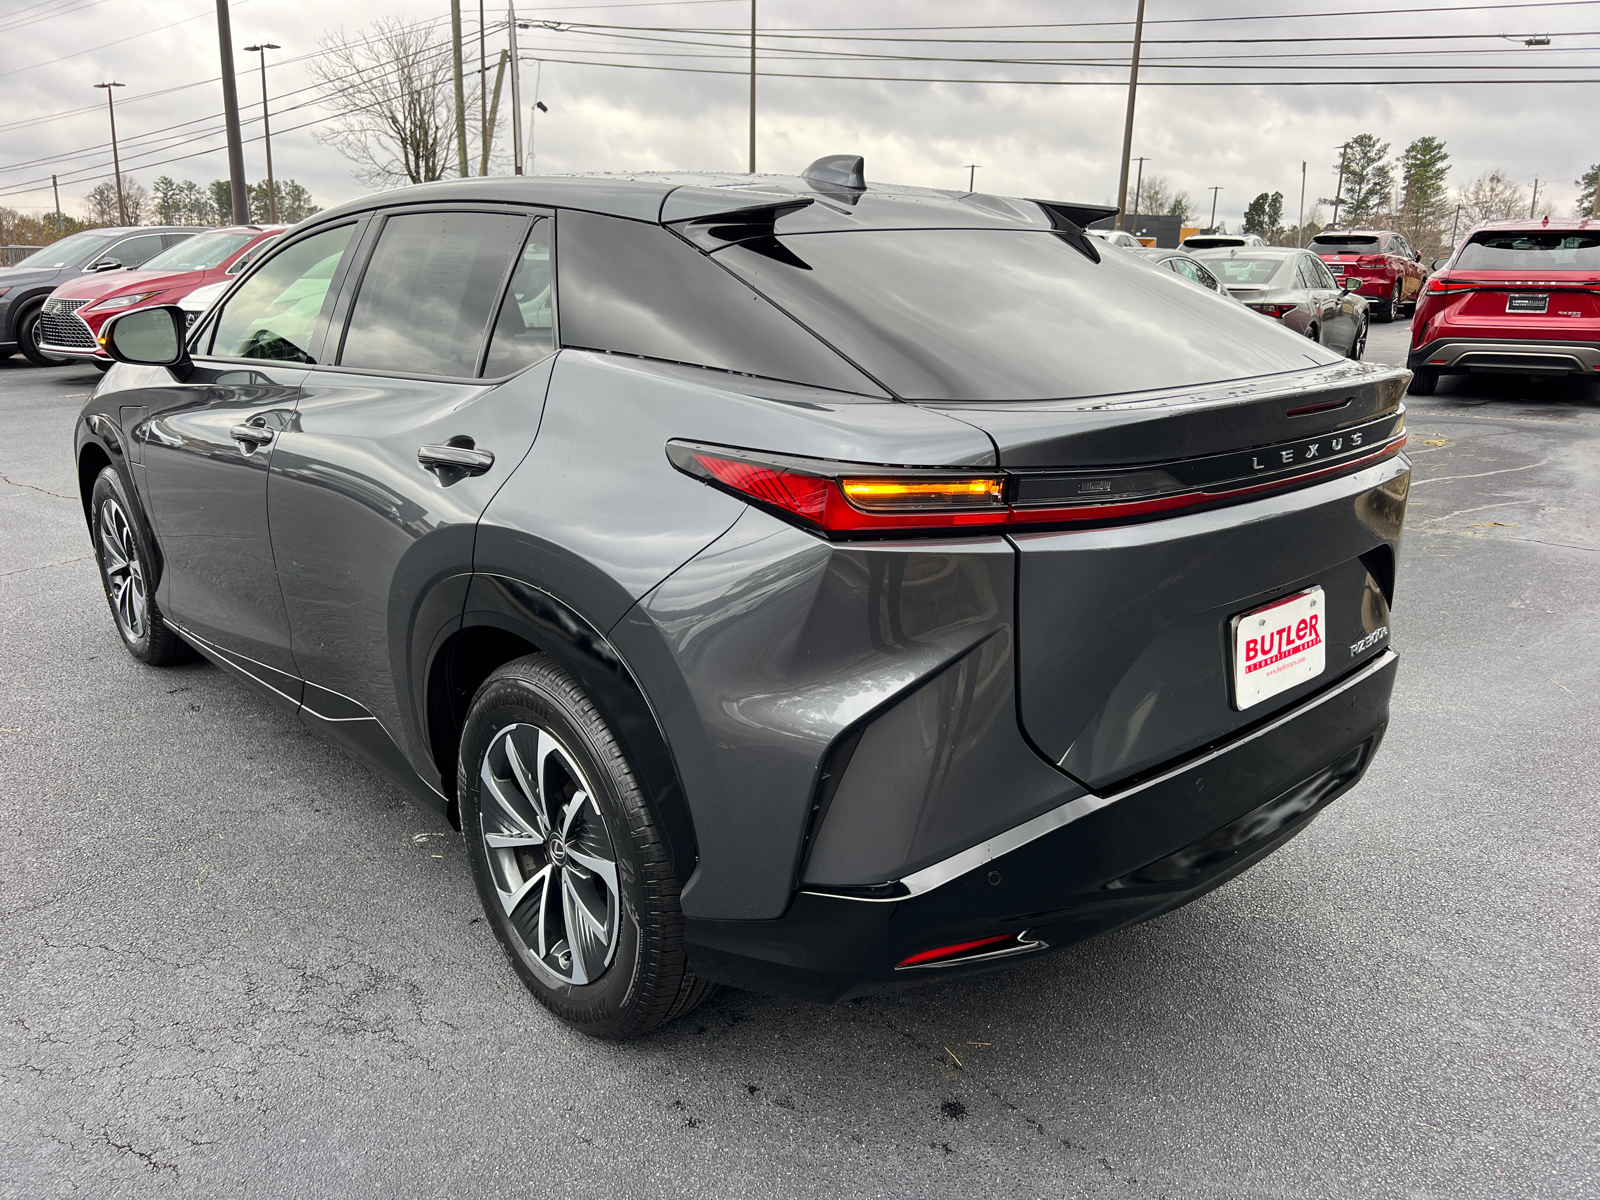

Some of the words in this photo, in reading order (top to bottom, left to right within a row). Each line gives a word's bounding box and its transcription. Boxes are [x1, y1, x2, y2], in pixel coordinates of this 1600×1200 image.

[1251, 432, 1363, 470] LEXUS
[1245, 649, 1294, 673] AUTOMOTIVE
[1299, 637, 1321, 651] GROUP
